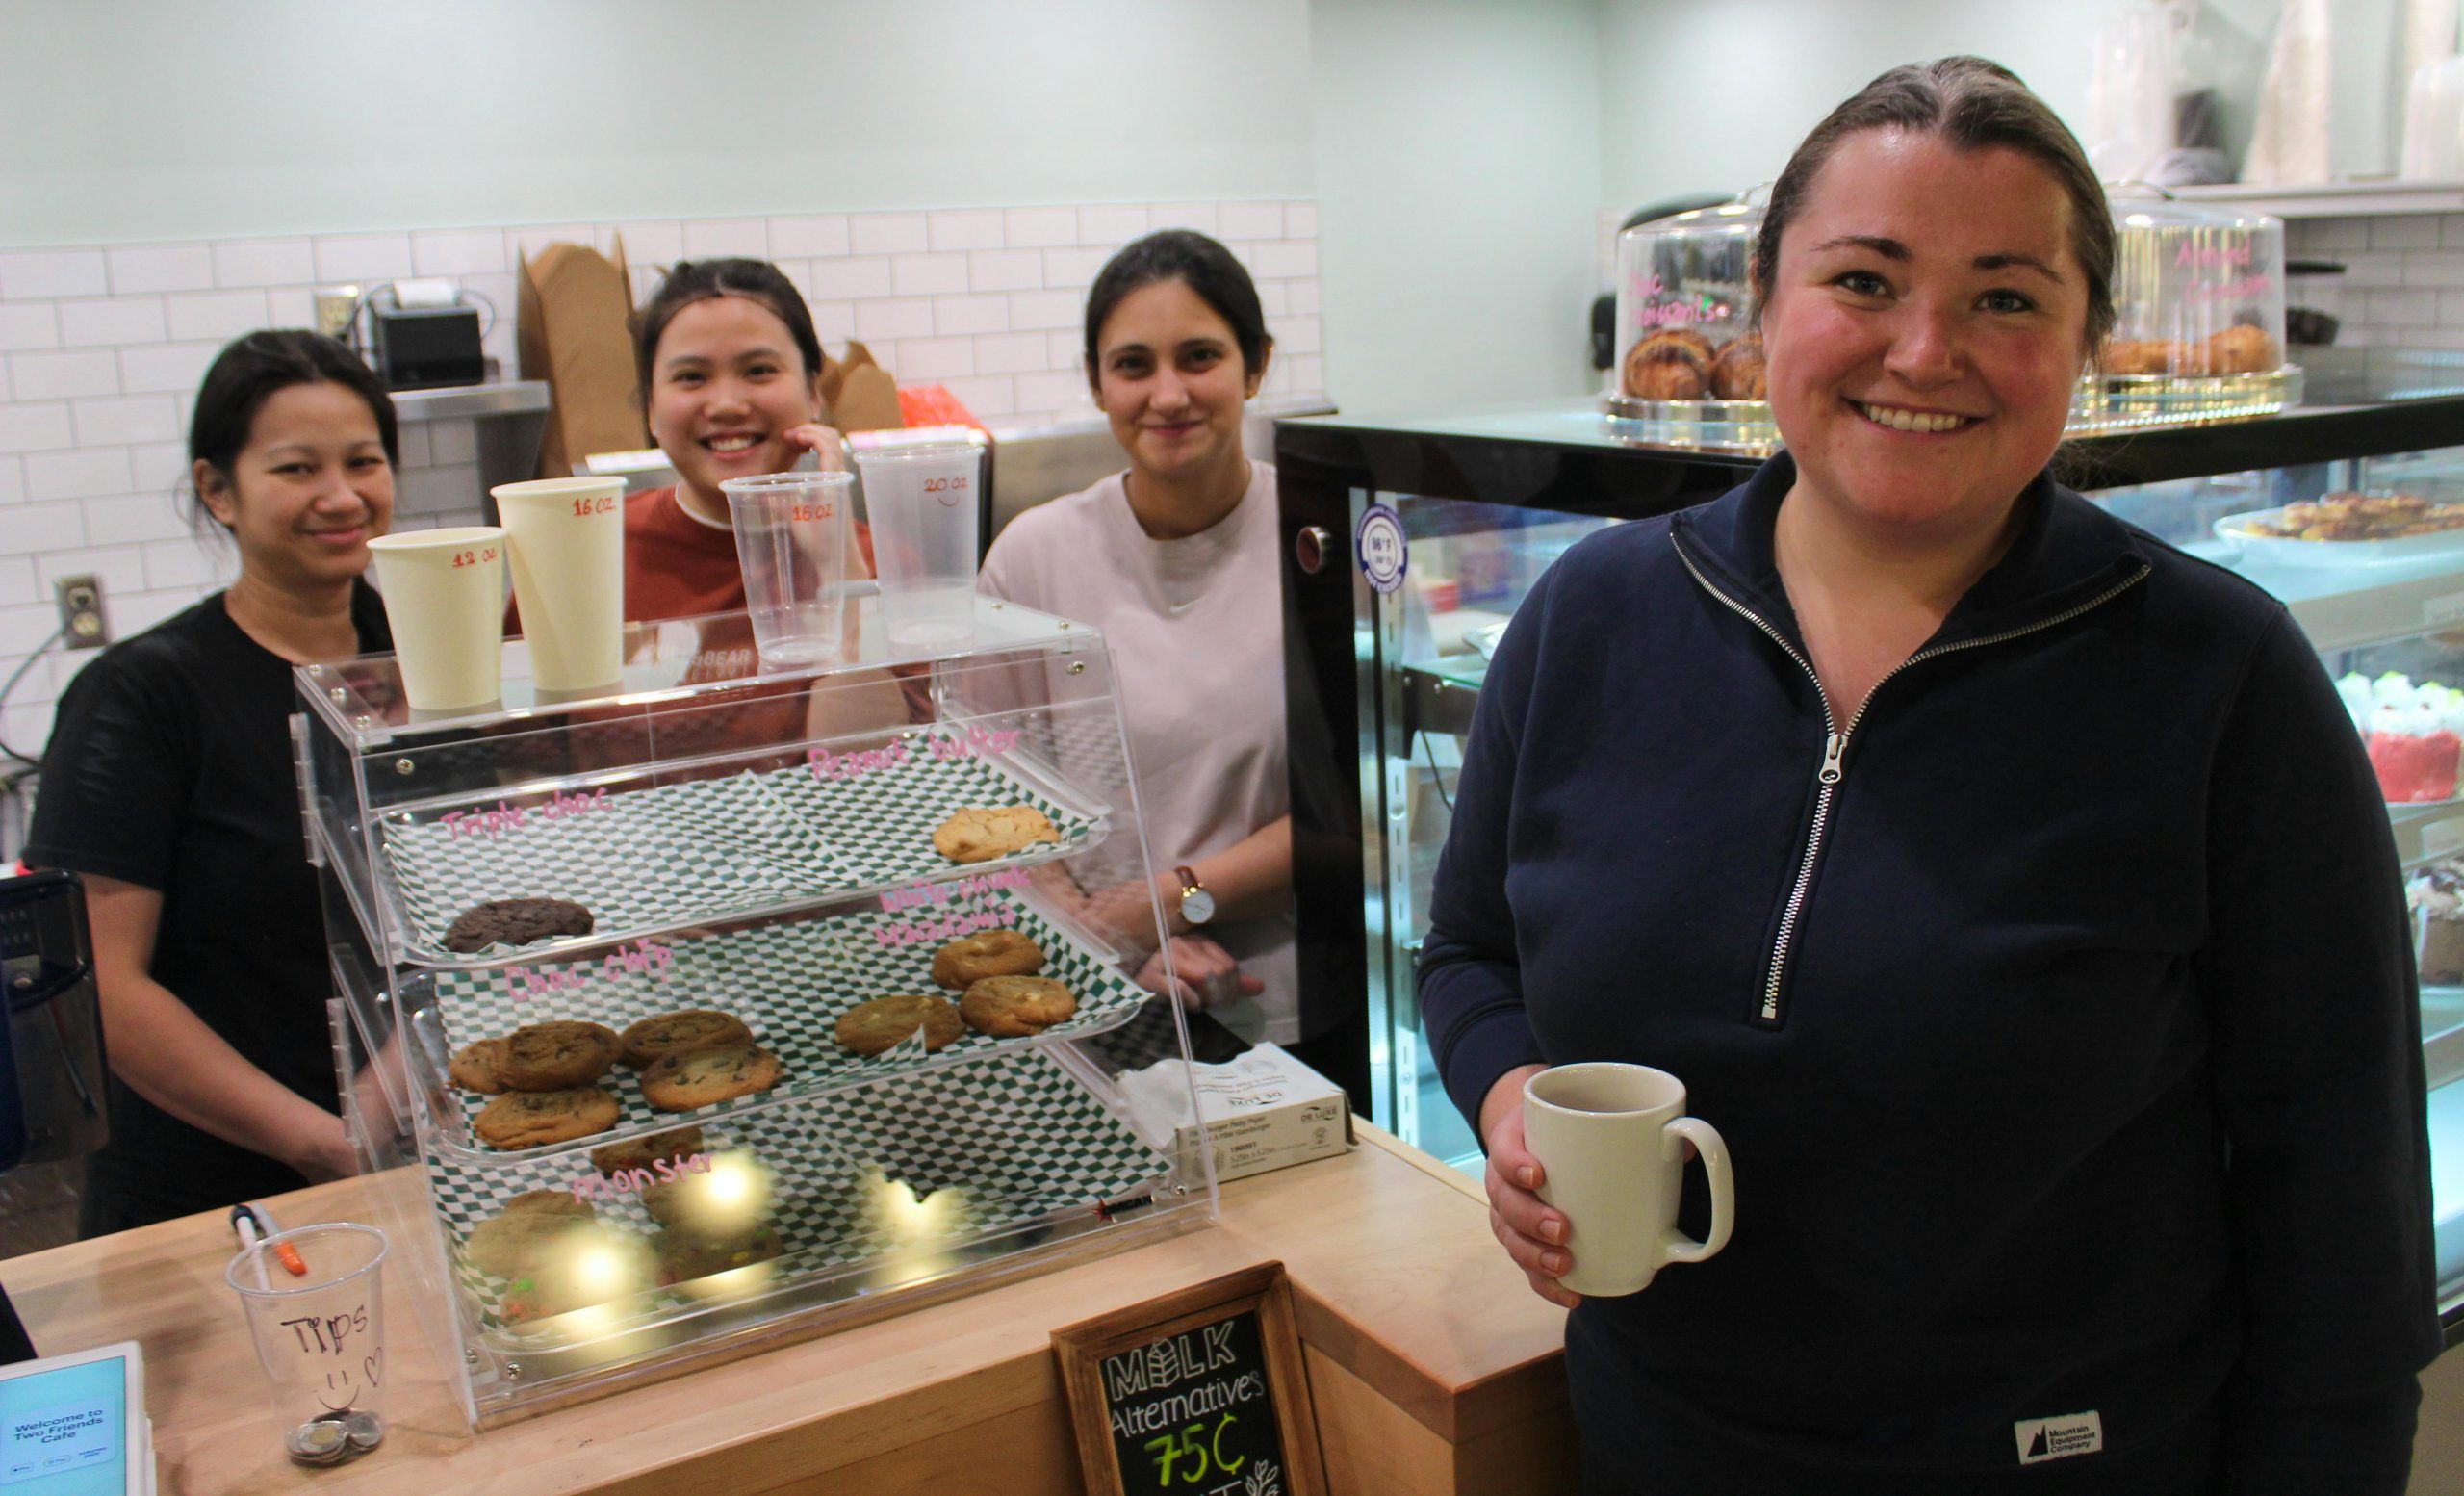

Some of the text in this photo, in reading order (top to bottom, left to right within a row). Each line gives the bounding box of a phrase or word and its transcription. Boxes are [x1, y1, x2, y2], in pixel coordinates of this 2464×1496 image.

[924, 478, 947, 492] 20
[573, 498, 592, 517] 16
[452, 551, 475, 568] 12
[1112, 1370, 1265, 1438] Alternatives
[15, 1413, 85, 1432] Welcome
[15, 1418, 104, 1440] Two Friends
[2049, 1426, 2089, 1438] Mountain
[2049, 1432, 2096, 1446] Equipment
[2051, 1440, 2091, 1454] Company
